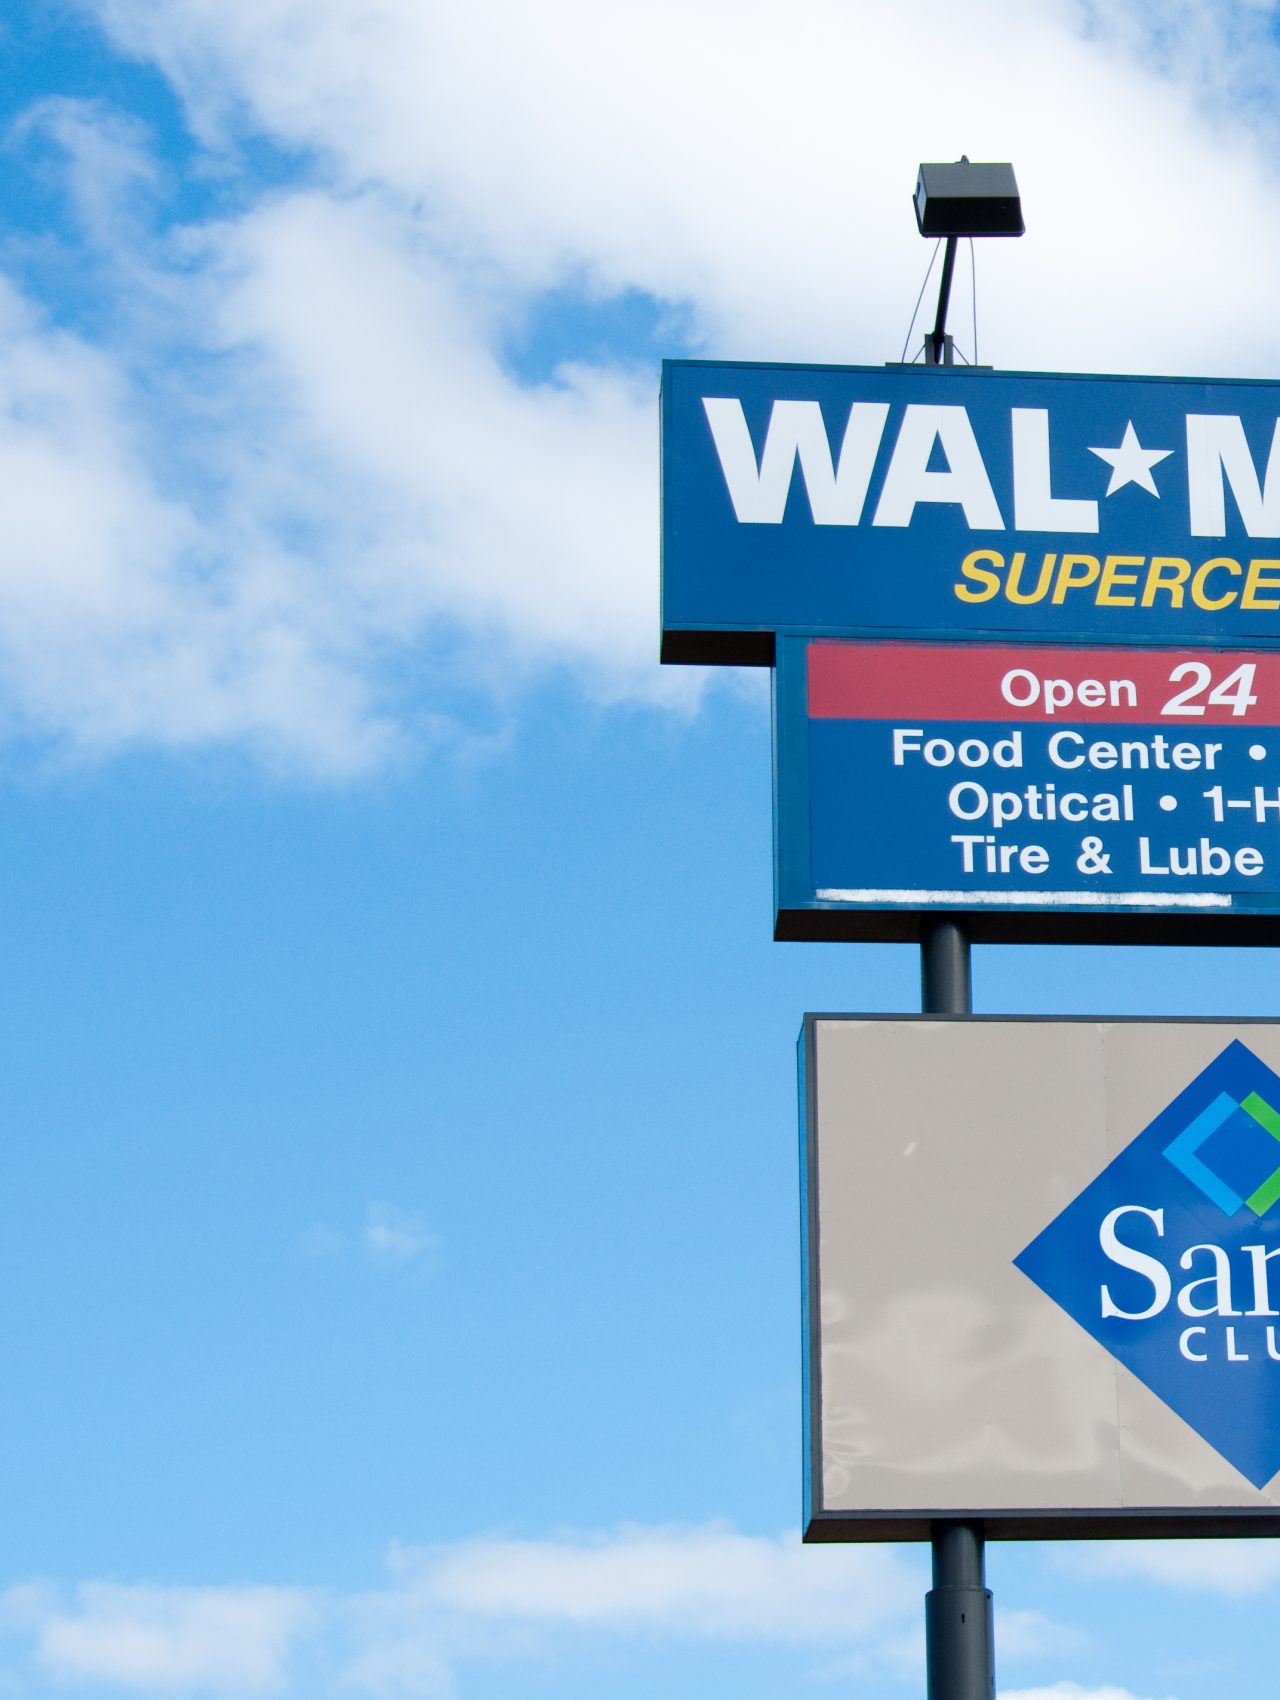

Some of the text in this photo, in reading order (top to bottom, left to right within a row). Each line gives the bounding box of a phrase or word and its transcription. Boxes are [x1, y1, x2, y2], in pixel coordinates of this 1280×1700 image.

[1000, 668, 1138, 715] Open
[1160, 661, 1258, 717] 24
[893, 729, 1023, 768] Food
[1048, 730, 1223, 771] Center
[948, 781, 1134, 828] Optical
[951, 835, 1050, 874] Tire
[1076, 836, 1113, 875] &
[1139, 837, 1264, 876] Lube
